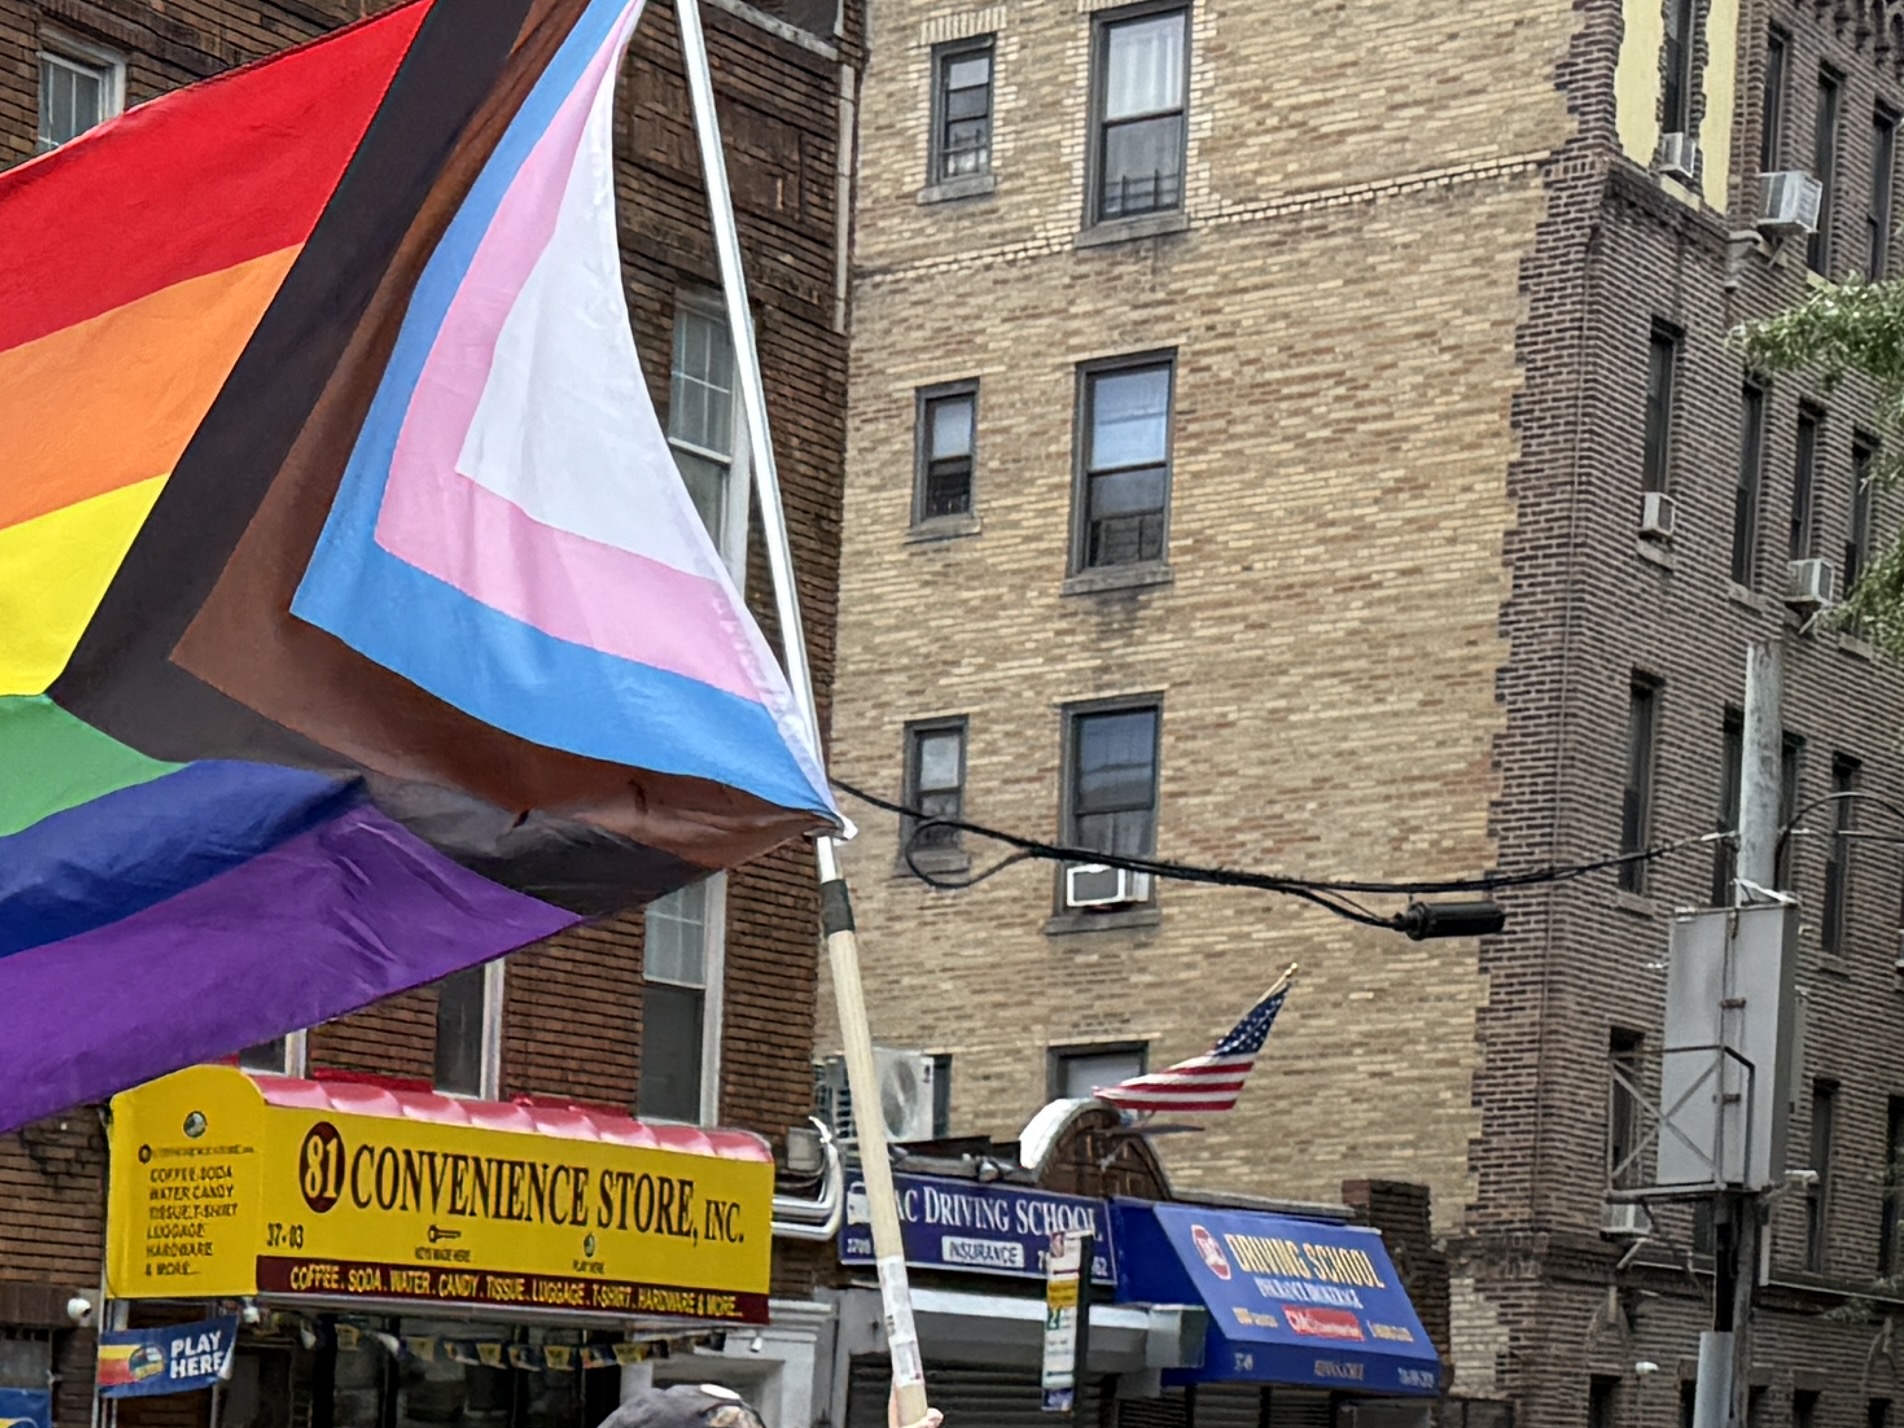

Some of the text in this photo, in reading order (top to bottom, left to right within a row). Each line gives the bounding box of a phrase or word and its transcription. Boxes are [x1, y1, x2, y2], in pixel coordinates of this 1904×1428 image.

[305, 1135, 338, 1198] 81
[350, 1144, 590, 1227] CONVENIENCE
[704, 1199, 744, 1244] INC.
[923, 1186, 1010, 1237] DRIVING
[1015, 1198, 1103, 1241] SCHOOL
[1223, 1234, 1313, 1280] DRIVING
[1302, 1242, 1386, 1289] SCHOOL
[170, 1331, 222, 1359] PLAY
